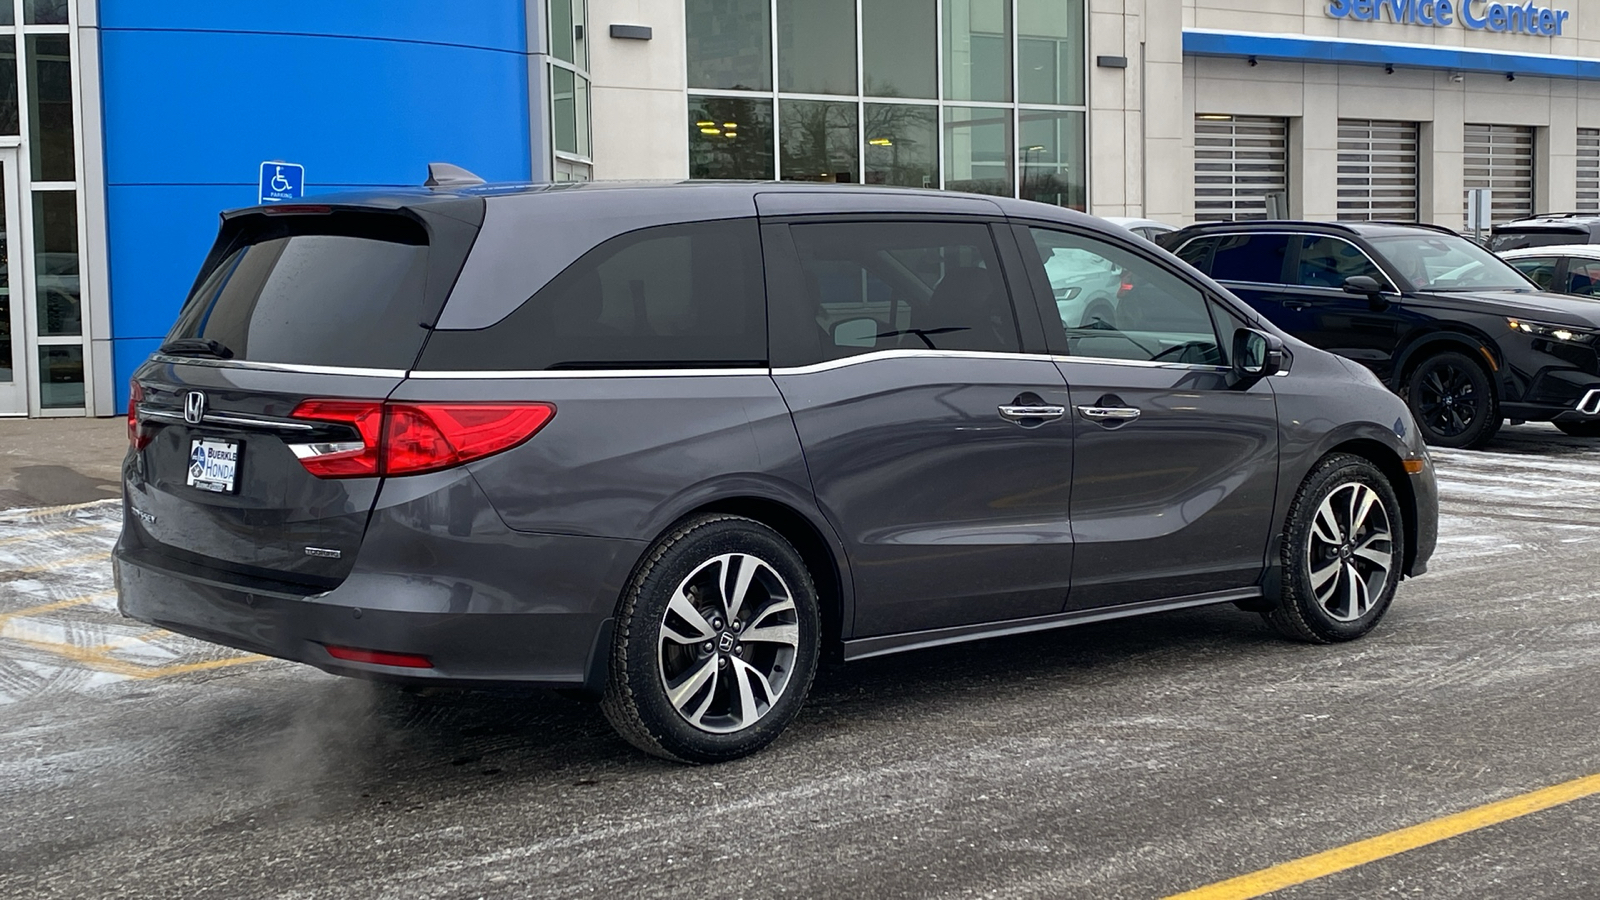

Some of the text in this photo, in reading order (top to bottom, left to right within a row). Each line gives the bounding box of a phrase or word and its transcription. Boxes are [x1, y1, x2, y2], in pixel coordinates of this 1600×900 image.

[1457, 0, 1569, 36] Center
[207, 447, 238, 462] BUERKLE
[205, 458, 235, 480] HONDA
